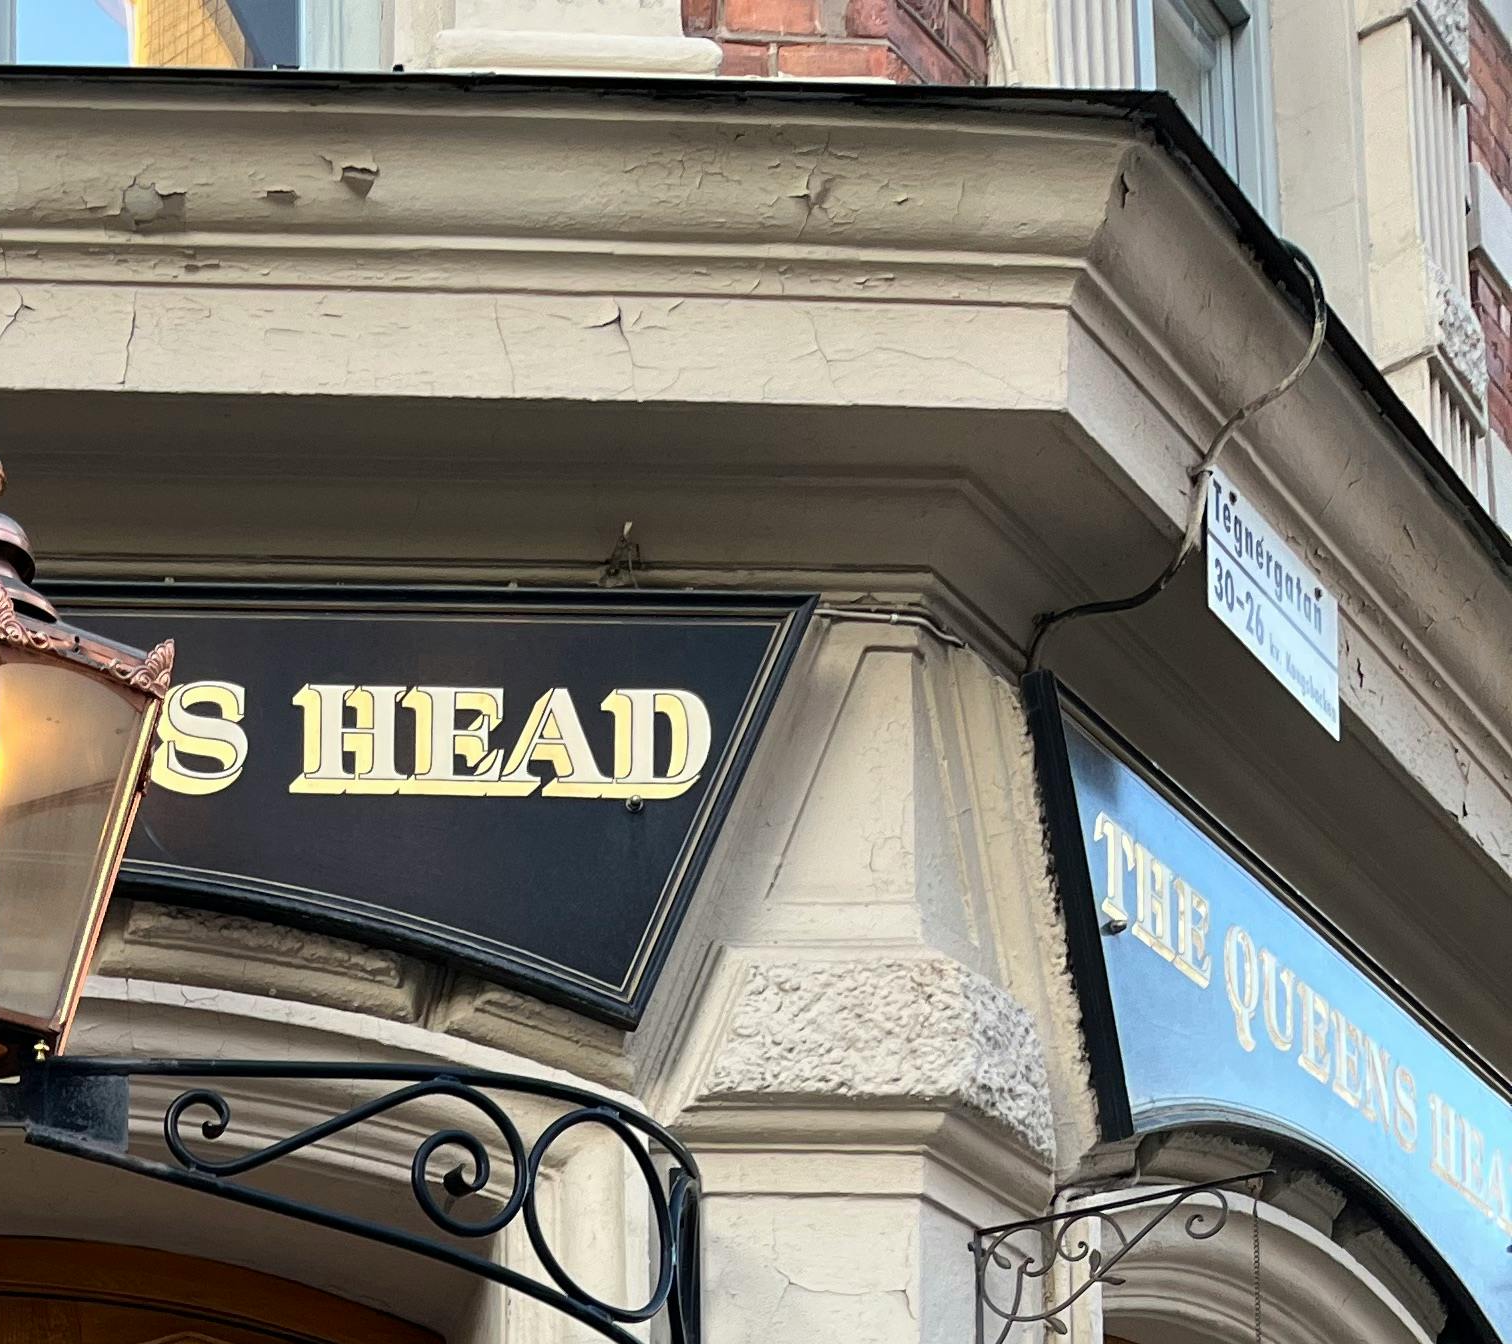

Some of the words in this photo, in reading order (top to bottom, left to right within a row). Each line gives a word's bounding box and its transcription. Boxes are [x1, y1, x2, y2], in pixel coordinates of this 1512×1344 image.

[1212, 477, 1324, 636] Tegnérgatan
[1213, 557, 1265, 647] 30-26
[290, 682, 714, 800] HEAD
[1093, 810, 1212, 989] THE
[1223, 924, 1419, 1153] QUEENS
[1428, 1092, 1512, 1238] HEA
